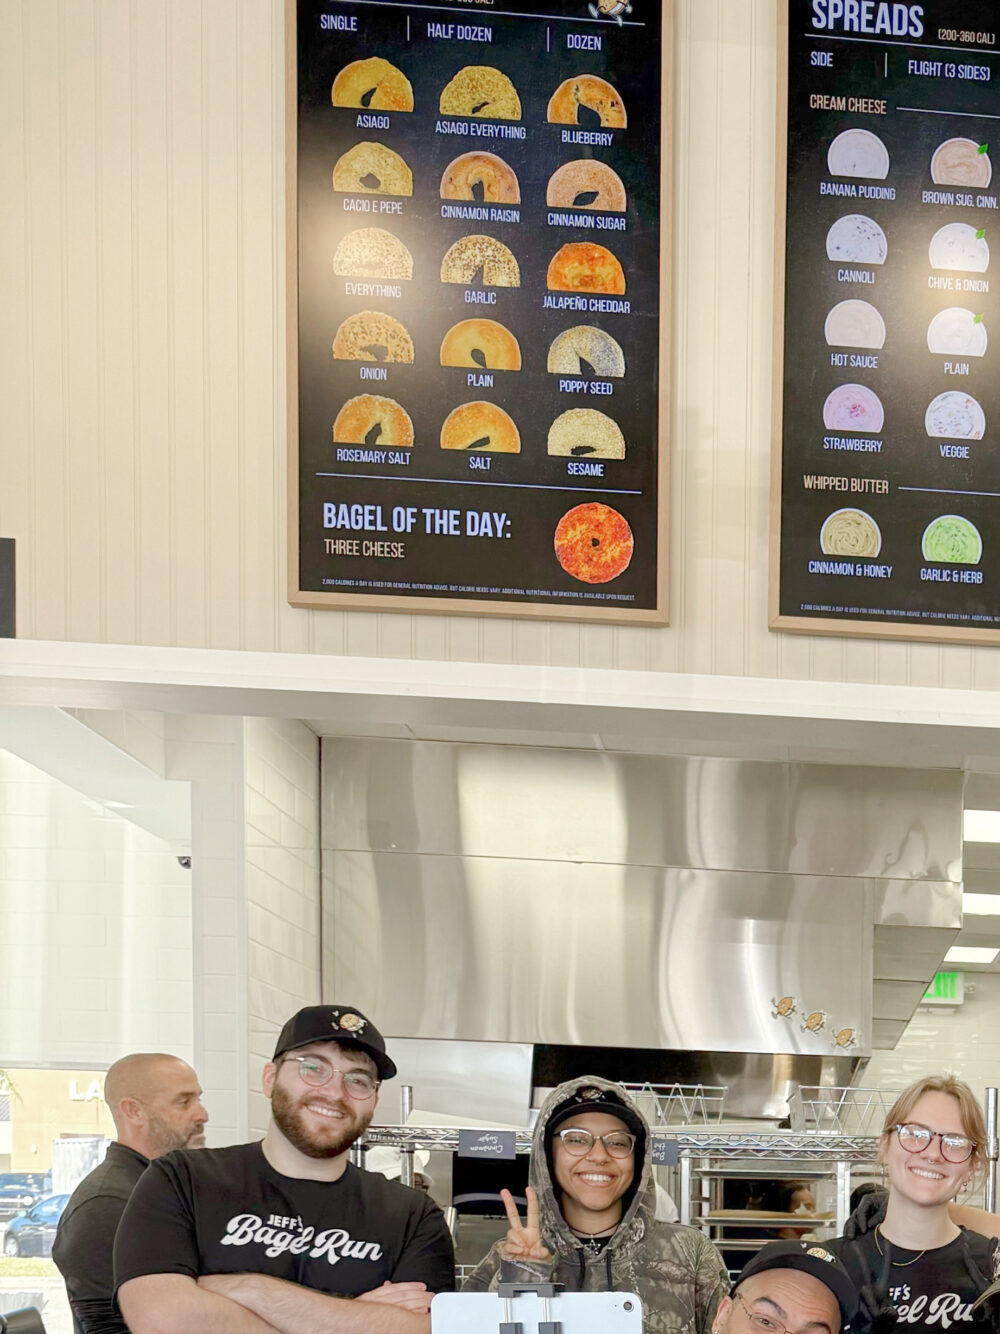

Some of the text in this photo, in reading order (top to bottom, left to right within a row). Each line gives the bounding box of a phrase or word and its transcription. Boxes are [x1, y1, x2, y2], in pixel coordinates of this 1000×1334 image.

[321, 15, 357, 31] SINGLE
[811, 0, 975, 42] SPREADS (200-360
[428, 23, 491, 42] HALF DOZEN
[567, 34, 601, 50] DOZEN
[811, 52, 833, 66] SIDE
[909, 60, 990, 80] FLIGHT SIDES)
[810, 95, 886, 114] CREAM CHEESE
[357, 115, 389, 129] ASIAGO
[436, 121, 526, 139] ASIAGO EVERYTHING
[562, 130, 613, 145] BLUEBERRY
[820, 183, 895, 200] BANANA PUDDING
[343, 199, 402, 214] CACIO PEPE
[923, 191, 998, 208] BROWN SUG. CINN.
[442, 205, 519, 222] CINNAMON RAISIN
[548, 213, 625, 230] CINNAMON SUGAR
[838, 270, 874, 284] CANNOLI
[929, 274, 988, 293] CHIVE ONION
[346, 283, 401, 297] EVERYTHING
[465, 291, 496, 304] GARLIC
[543, 294, 630, 313] JALAPEÑO CHEDDAR
[831, 354, 878, 368] HOT SAUCE
[945, 362, 969, 375] PLAIN
[360, 367, 387, 380] ONION
[468, 374, 493, 386] PLAIN
[560, 380, 612, 394] POPPY SEED
[824, 437, 882, 452] STRAWBERRY
[940, 445, 969, 458] VEGGIE
[337, 449, 410, 464] ROSEMARY SALT
[470, 457, 491, 469] SALT
[568, 463, 603, 476] SESAME
[804, 475, 888, 493] WHIPPED BUTTER
[324, 503, 510, 537] BAGEL OF THE DAY:
[324, 539, 404, 557] THREE CHEESE
[809, 561, 892, 577] CINNAMON HONEY
[921, 569, 982, 583] GARLIC HERB
[923, 972, 957, 998] XIT
[477, 1133, 498, 1143] Sugar
[470, 1145, 503, 1153] Cinnamon
[220, 1213, 383, 1265] Bagel Run
[925, 1293, 974, 1329] Ru
